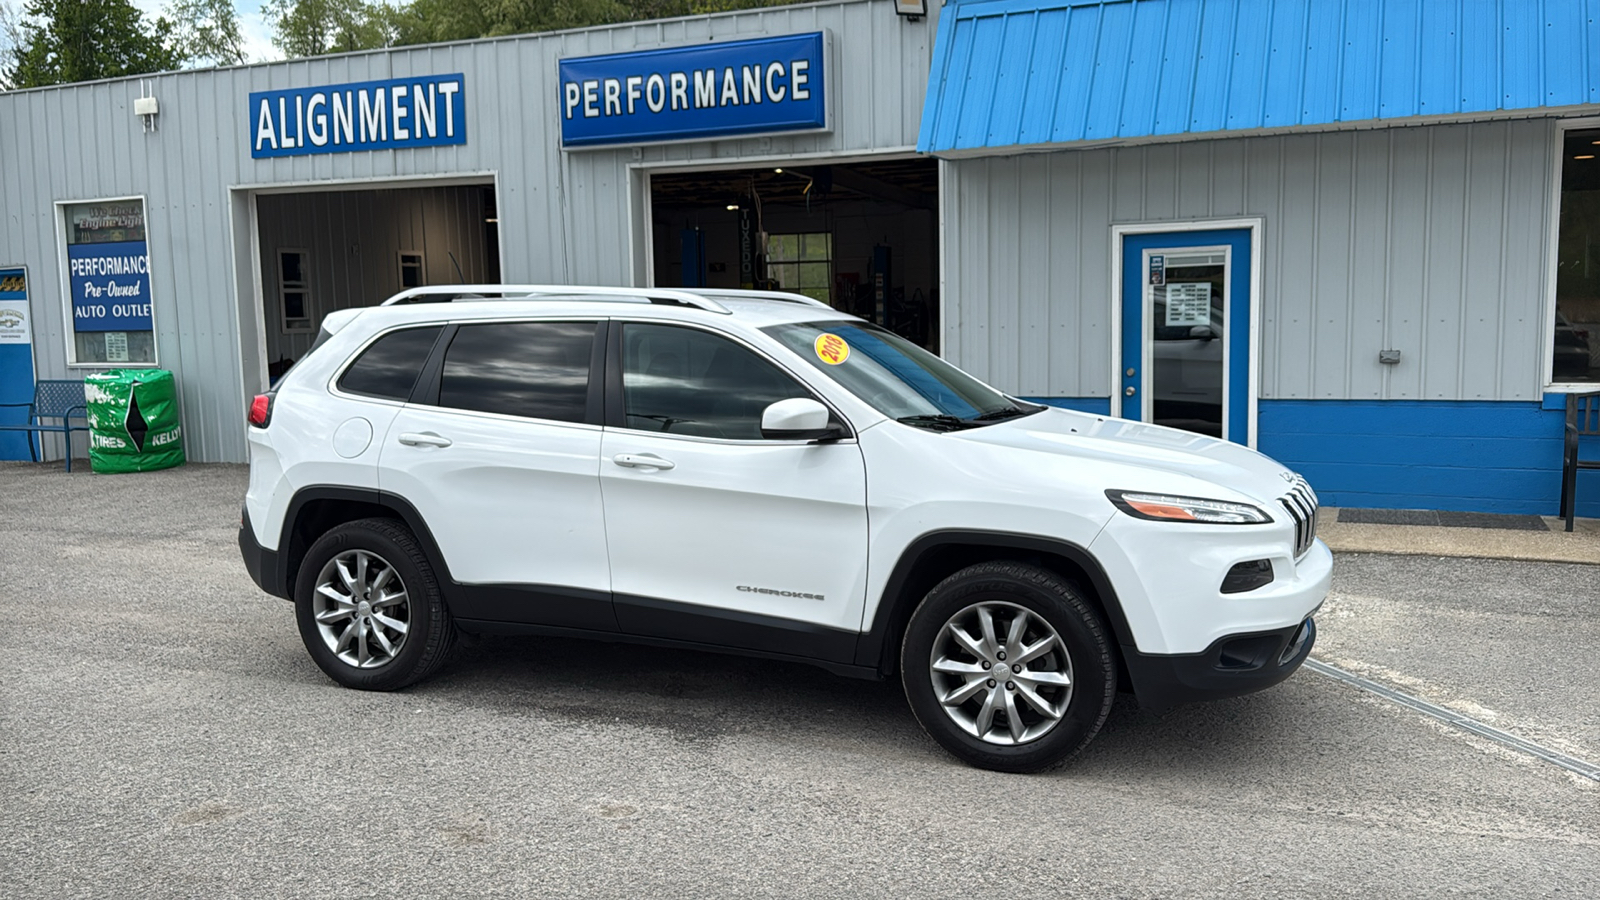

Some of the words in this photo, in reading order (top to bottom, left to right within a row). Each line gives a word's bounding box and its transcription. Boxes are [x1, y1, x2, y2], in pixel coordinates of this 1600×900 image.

[565, 60, 810, 120] PERFORMANCE
[255, 81, 459, 151] ALIGNMENT
[80, 218, 116, 230] Engine
[740, 208, 752, 273] TUXEDO
[84, 280, 140, 298] Pre-Owned
[75, 304, 106, 318] AUTO
[821, 335, 843, 362] 2018
[95, 433, 126, 449] TIRES
[736, 585, 825, 601] CHEROKEE
